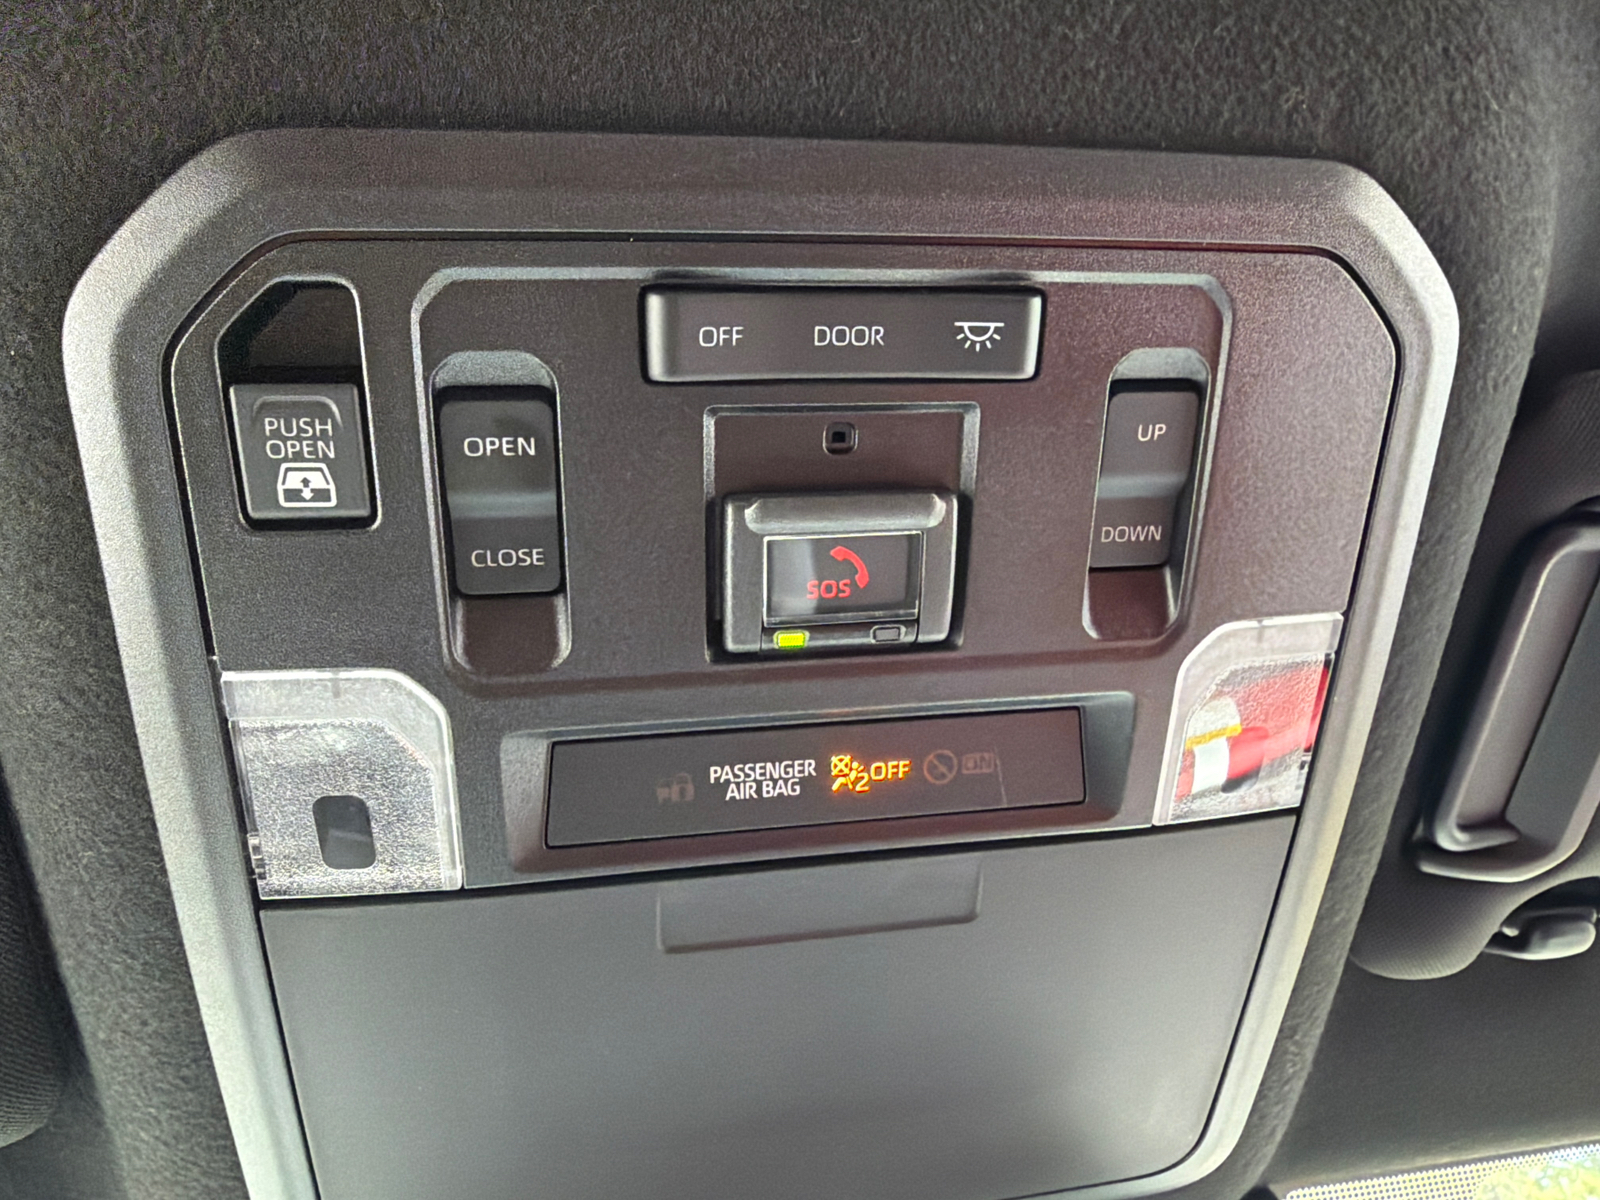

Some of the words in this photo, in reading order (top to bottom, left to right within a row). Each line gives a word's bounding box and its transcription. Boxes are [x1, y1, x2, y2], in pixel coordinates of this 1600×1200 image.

[699, 326, 744, 347] OFF
[813, 325, 885, 347] DOOR
[264, 418, 333, 437] PUSH
[1137, 424, 1167, 442] UP
[265, 440, 336, 459] OPEN
[463, 437, 536, 457] OPEN
[1100, 526, 1162, 543] DOWN
[471, 549, 545, 568] CLOSE
[806, 579, 851, 599] SOS
[709, 759, 817, 784] PASSENGER
[870, 760, 911, 782] OFF
[725, 783, 758, 801] AIR
[762, 779, 801, 799] BAG
